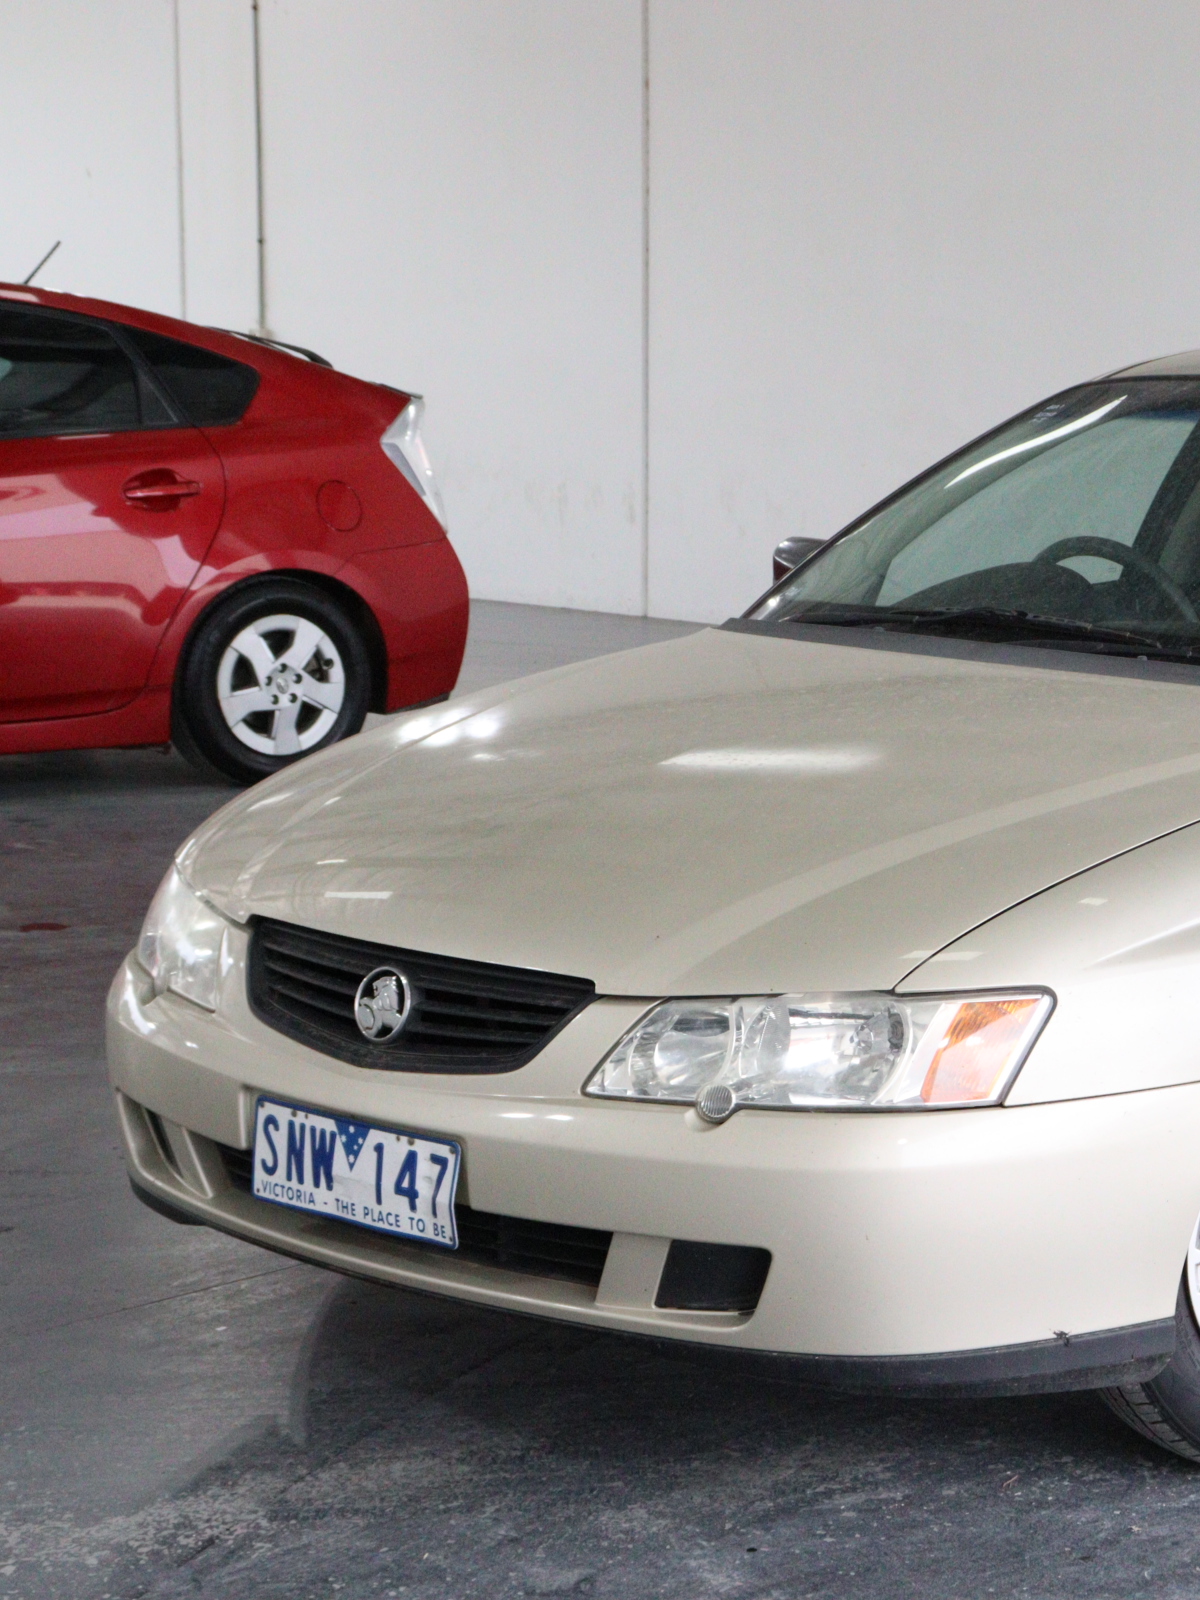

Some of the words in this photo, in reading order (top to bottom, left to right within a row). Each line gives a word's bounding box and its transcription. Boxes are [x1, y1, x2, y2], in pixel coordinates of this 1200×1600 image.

[260, 1114, 337, 1191] SNW
[373, 1142, 449, 1218] 147
[260, 1179, 316, 1207] VICTORIA
[335, 1198, 357, 1217] THE
[363, 1206, 401, 1228] PLACE
[408, 1217, 426, 1233] TO
[433, 1222, 447, 1240] BE
